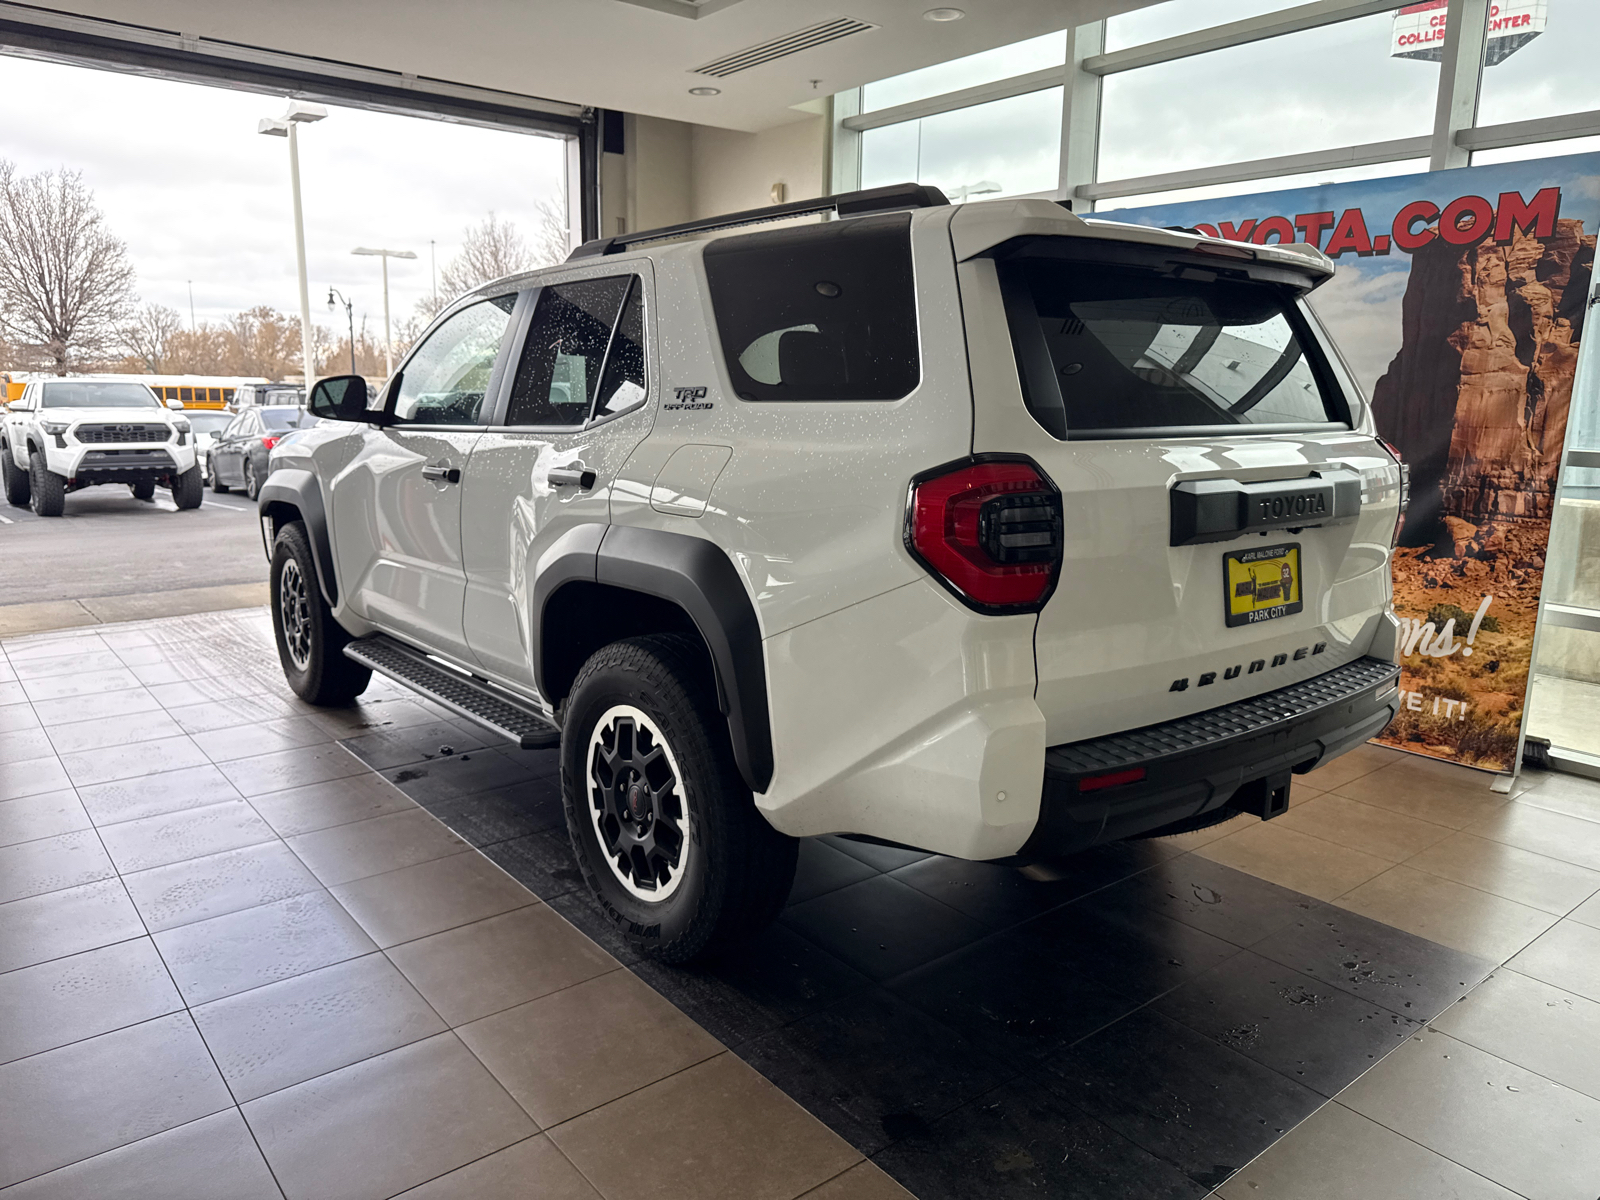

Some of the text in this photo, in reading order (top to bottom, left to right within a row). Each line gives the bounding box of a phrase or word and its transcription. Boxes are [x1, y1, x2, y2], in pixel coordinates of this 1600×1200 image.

[1398, 28, 1446, 46] COLLIS
[673, 386, 708, 403] TRD
[1260, 493, 1326, 520] TOYOTA
[1282, 567, 1290, 578] 32
[1248, 605, 1287, 623] PARK CITY
[1433, 696, 1468, 722] IT!
